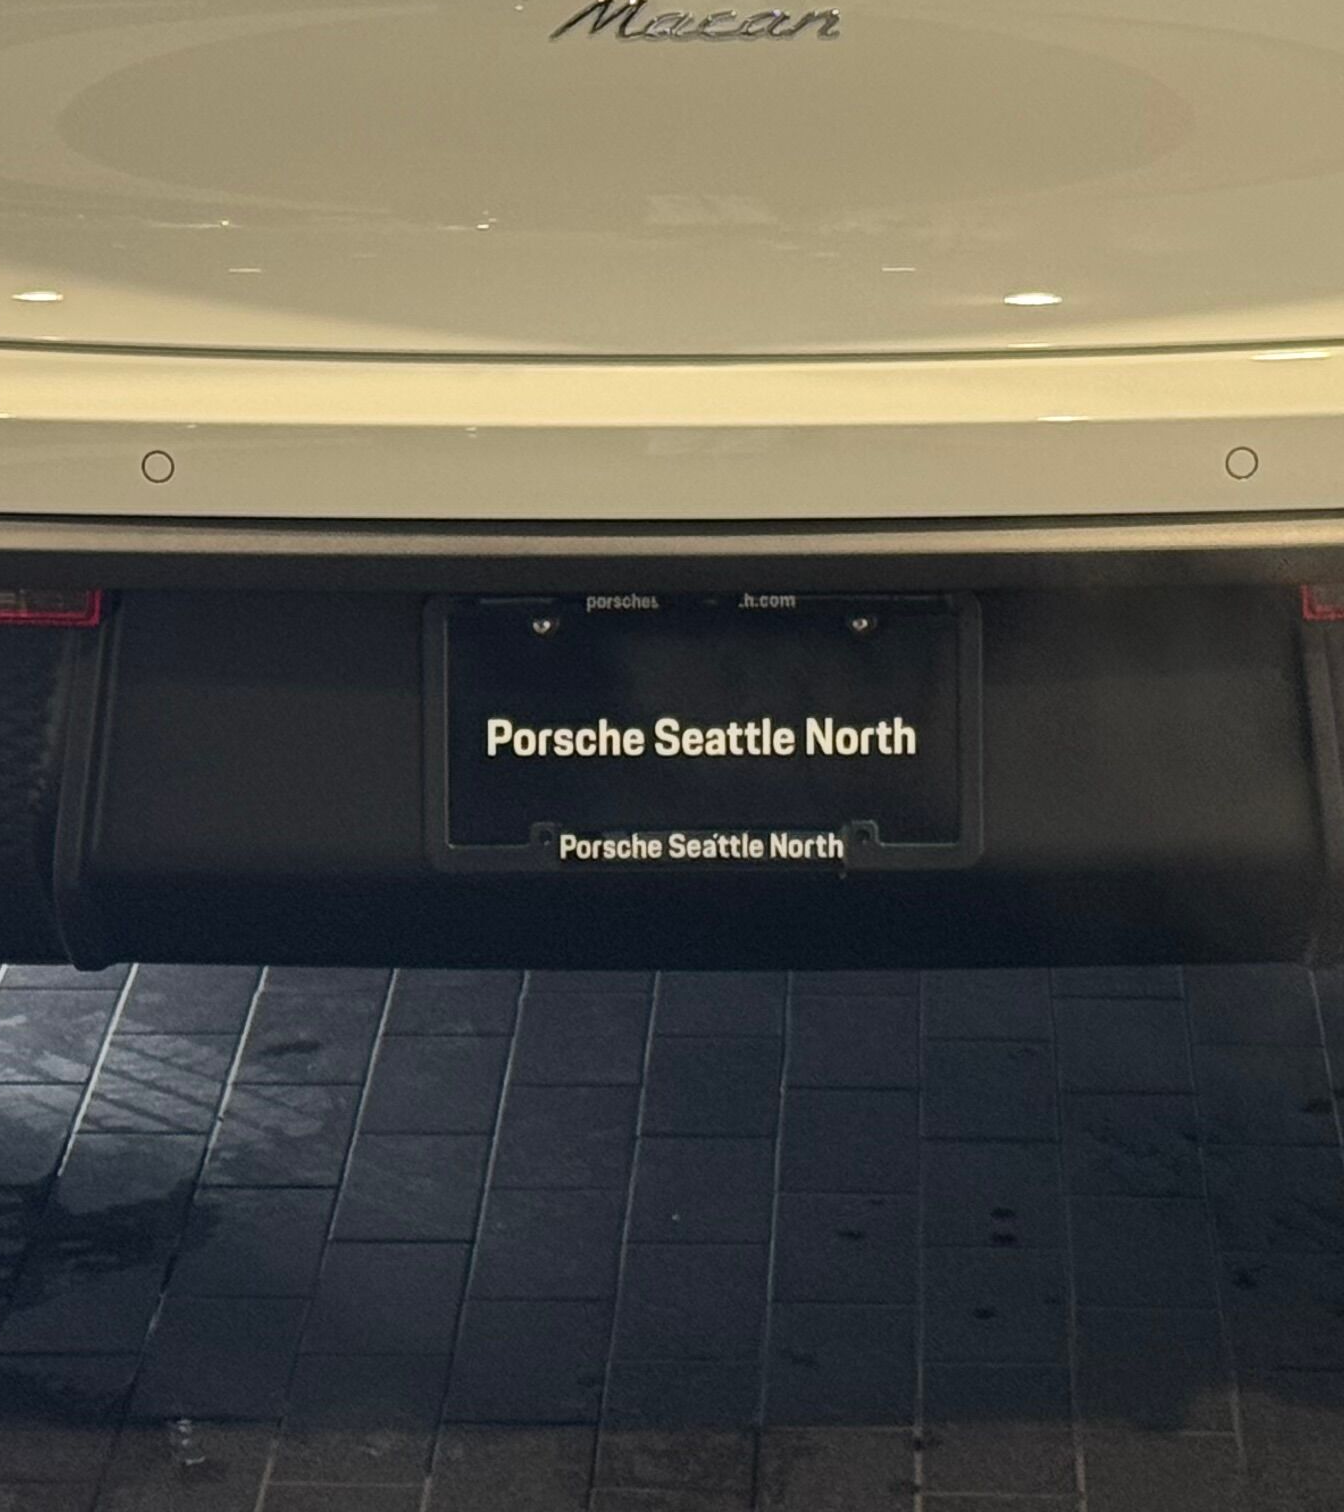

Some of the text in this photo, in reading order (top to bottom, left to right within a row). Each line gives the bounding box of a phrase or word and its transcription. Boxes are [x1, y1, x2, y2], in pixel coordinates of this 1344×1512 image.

[487, 716, 917, 757] Porsche Seattle North
[559, 831, 845, 860] Porsche Seattle North
